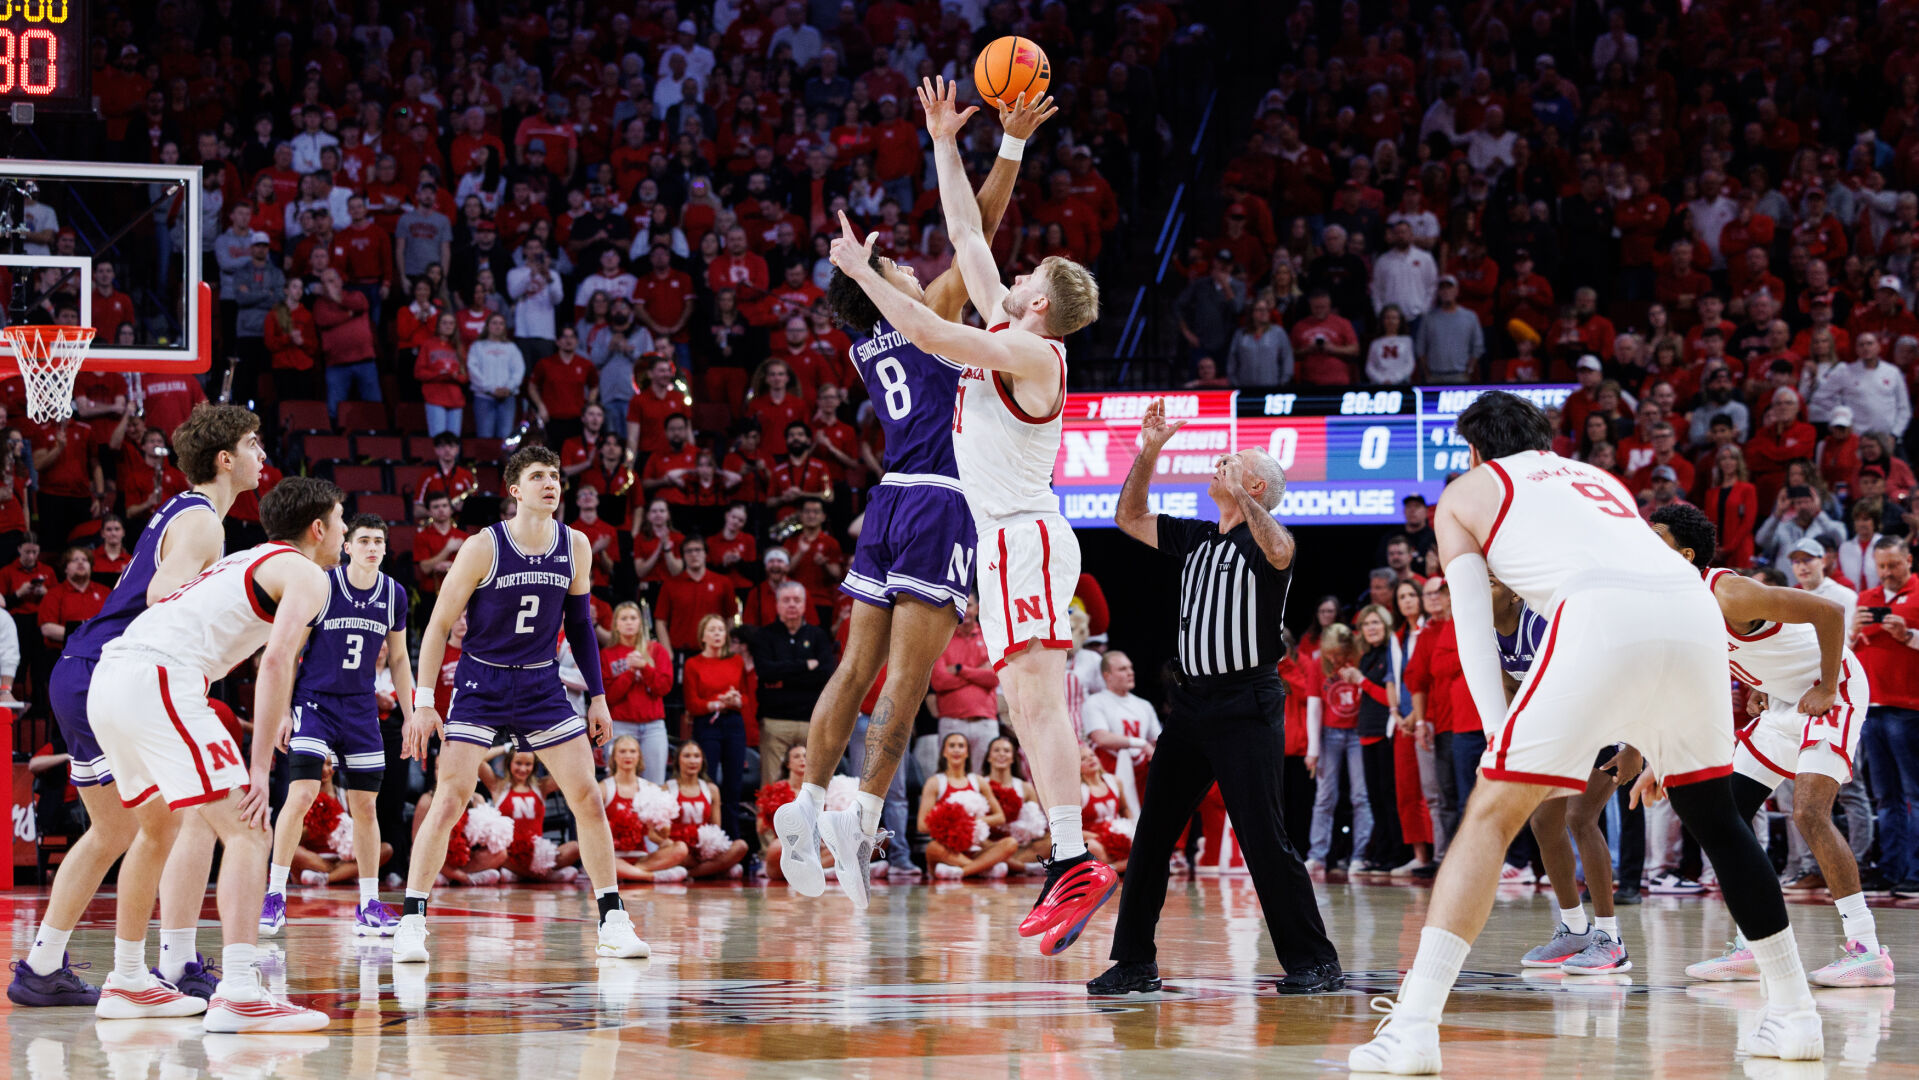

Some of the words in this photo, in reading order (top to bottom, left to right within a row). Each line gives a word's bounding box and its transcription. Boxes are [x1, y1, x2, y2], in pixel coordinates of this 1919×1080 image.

[1382, 345, 1399, 360] N
[875, 356, 912, 420] 8
[1264, 393, 1297, 415] 1ST
[1340, 391, 1402, 415] 20:00
[1064, 430, 1109, 478] N
[1267, 427, 1298, 471] 0
[1358, 426, 1391, 470] 0
[1156, 455, 1171, 475] 0
[1571, 482, 1637, 518] 9
[946, 542, 974, 588] N
[495, 571, 571, 590] NORTHWESTERN
[515, 595, 540, 634] 2
[1014, 595, 1044, 624] N
[323, 617, 388, 636] NORTHWESTERN
[342, 634, 364, 670] 3
[1122, 719, 1141, 738] N
[206, 739, 240, 771] N
[512, 796, 536, 819] N
[681, 801, 705, 824] N
